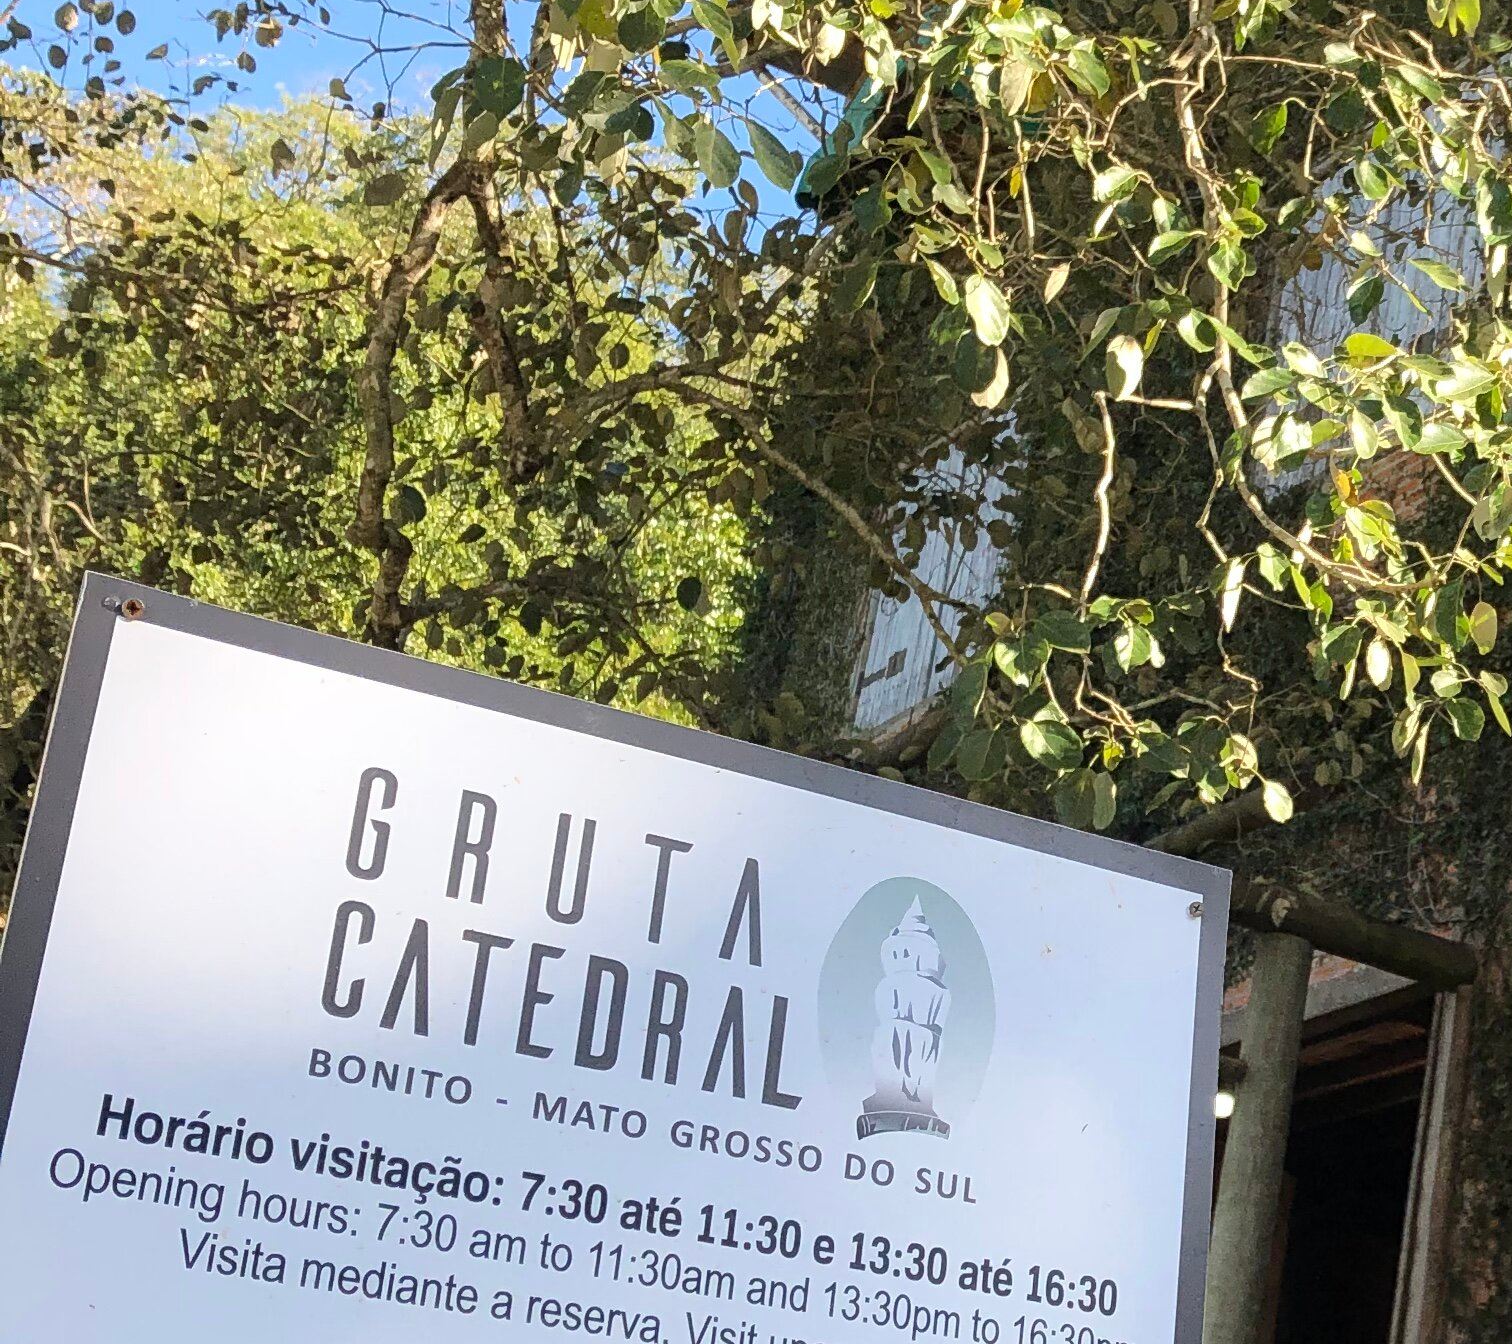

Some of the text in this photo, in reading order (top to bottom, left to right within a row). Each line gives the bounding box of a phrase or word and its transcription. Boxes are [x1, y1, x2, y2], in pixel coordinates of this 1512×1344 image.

[345, 766, 763, 968] GRUTA
[321, 899, 803, 1111] CATEDRAL
[96, 1093, 1118, 1317] Horário visitação: 7:30 até 11:30 e 13:30 até 16:30
[308, 1047, 473, 1105] BONITO
[532, 1091, 648, 1139] MATO
[670, 1119, 823, 1173] GROSSO
[843, 1152, 895, 1187] DO
[914, 1167, 977, 1204] SUL
[49, 1147, 226, 1224] Opening
[237, 1178, 362, 1237] hours:
[376, 1202, 458, 1253] 7:30
[468, 1229, 527, 1265] am
[539, 1232, 573, 1273] to
[589, 1240, 735, 1301] 11:30am
[745, 1276, 811, 1313] and
[824, 1281, 961, 1342] 13:30pm
[179, 1227, 287, 1285] Visita
[299, 1258, 479, 1315] mediante
[490, 1290, 513, 1321] a
